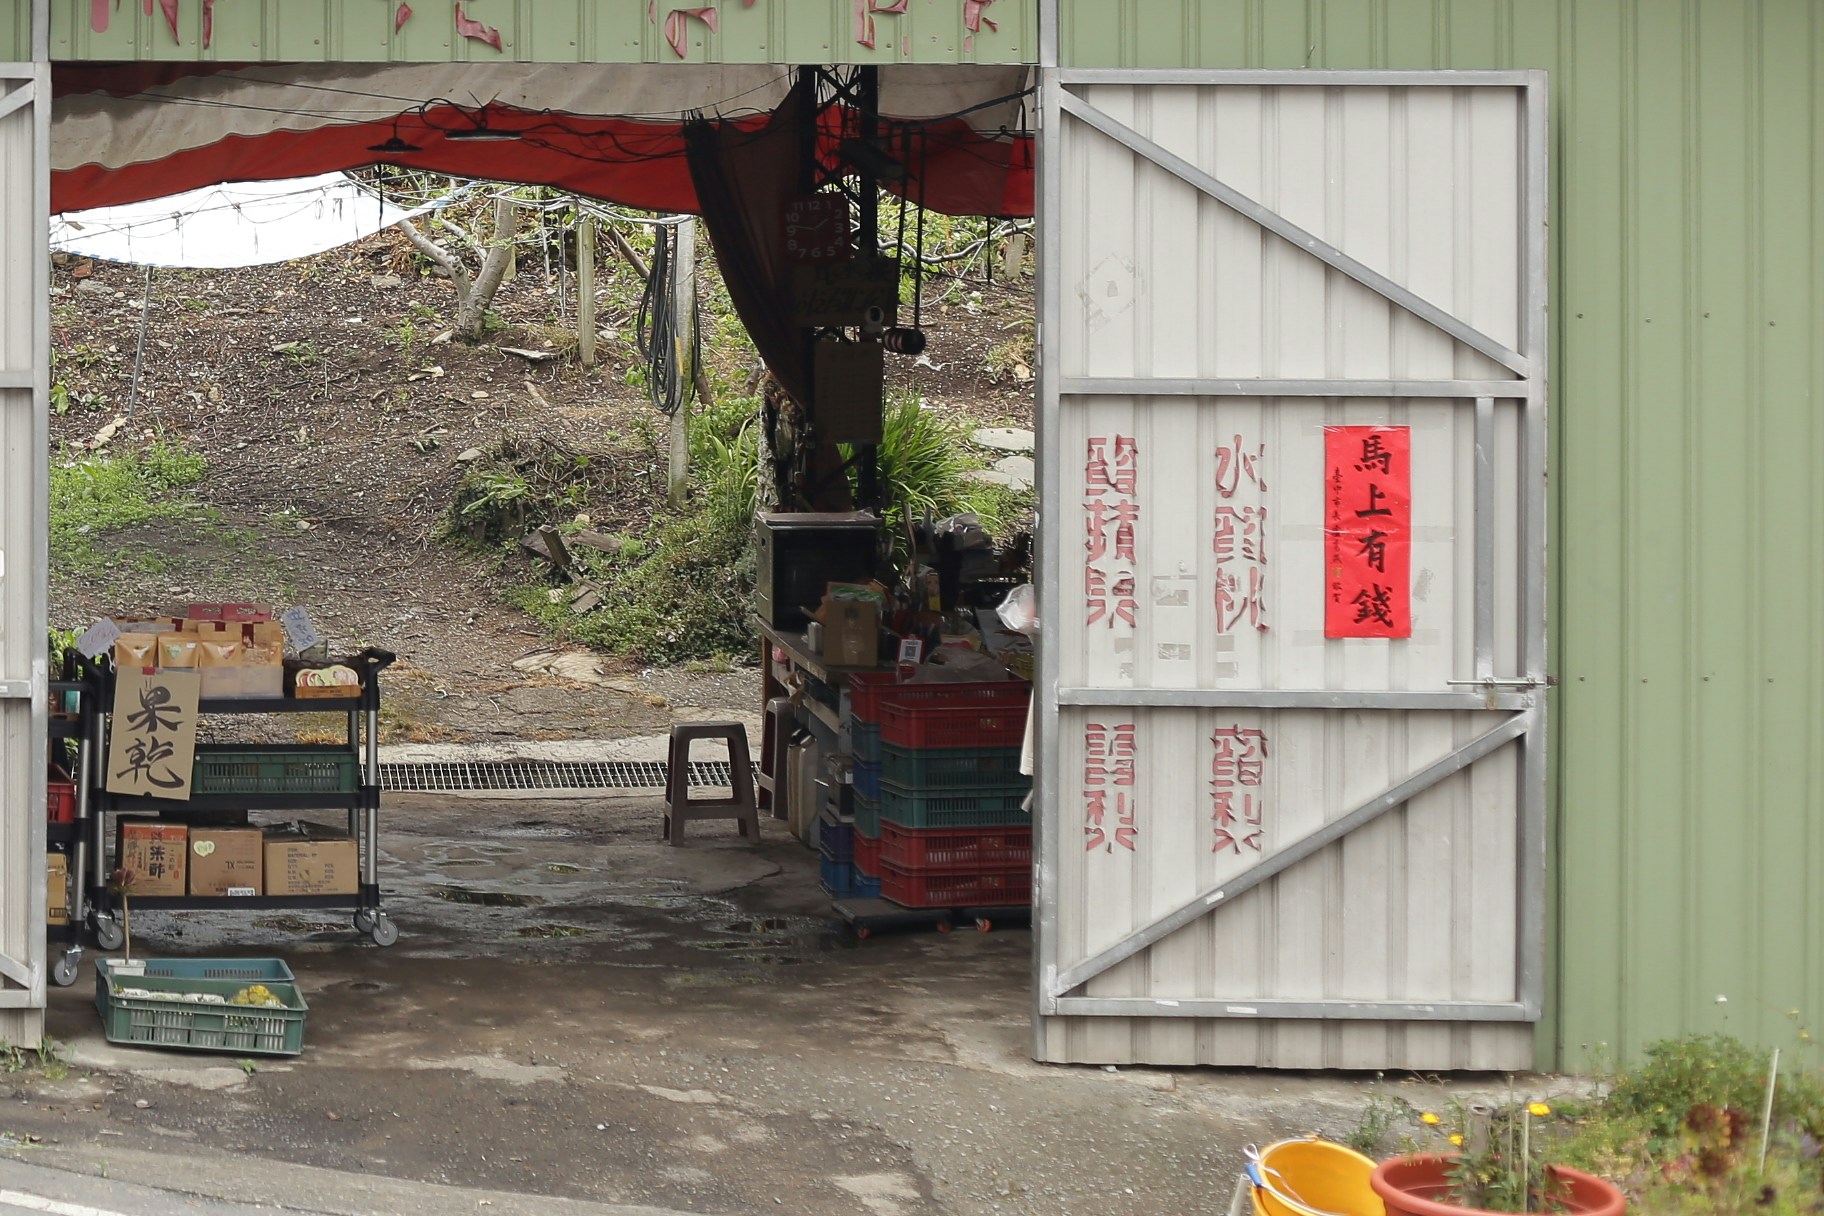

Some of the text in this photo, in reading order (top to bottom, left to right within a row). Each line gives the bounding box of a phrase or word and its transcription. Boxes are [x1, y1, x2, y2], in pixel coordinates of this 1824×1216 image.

[793, 202, 804, 211] 11
[808, 200, 820, 210] 12
[785, 212, 799, 222] 10
[834, 209, 842, 219] 2
[786, 225, 796, 237] 9
[835, 223, 844, 233] 3
[788, 239, 797, 251] 8
[834, 236, 844, 247] 4
[798, 248, 807, 258] 7
[811, 248, 821, 258] 6
[826, 246, 835, 256] 5
[1351, 434, 1395, 629] 馬上有錢
[115, 685, 185, 790] 果乾
